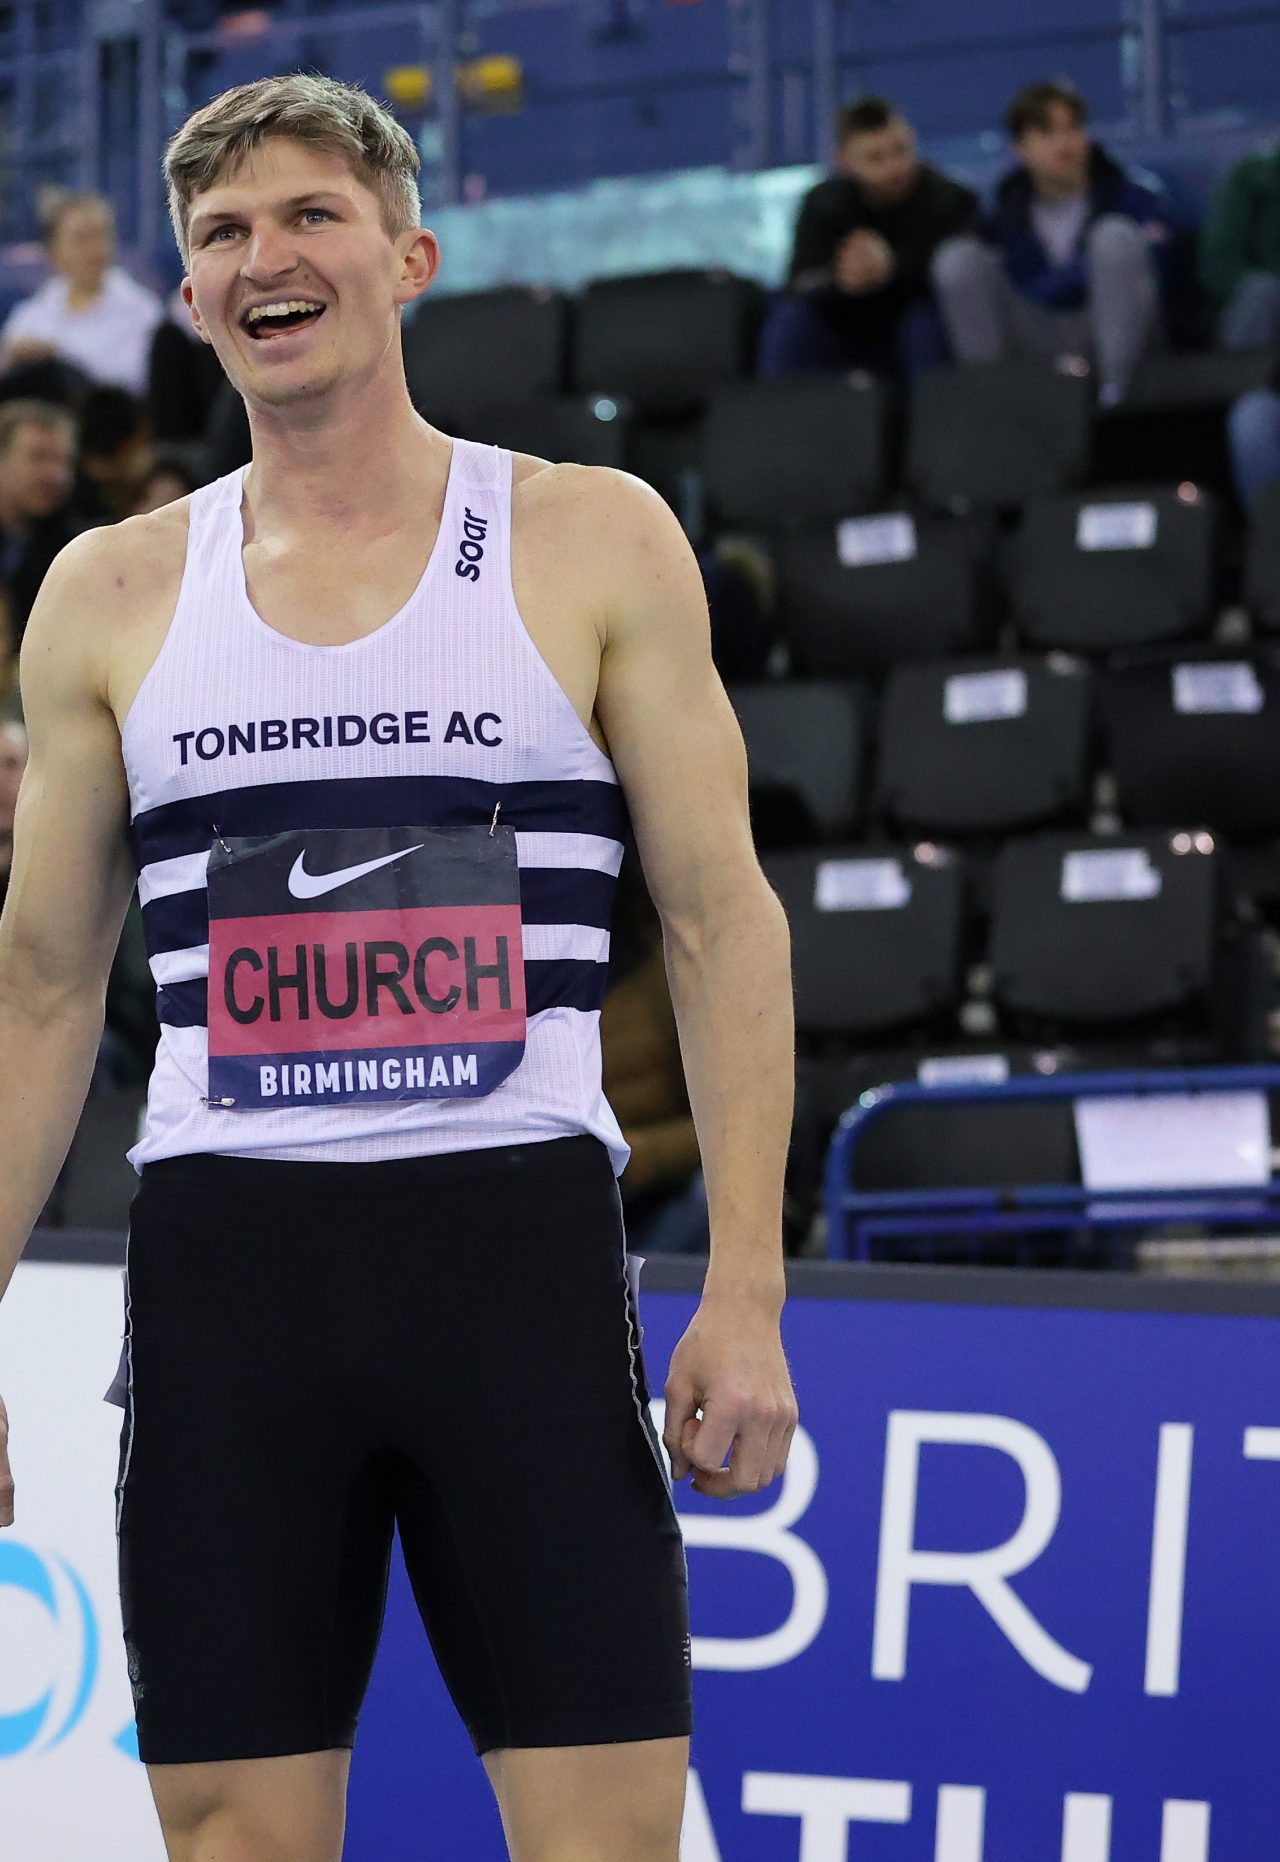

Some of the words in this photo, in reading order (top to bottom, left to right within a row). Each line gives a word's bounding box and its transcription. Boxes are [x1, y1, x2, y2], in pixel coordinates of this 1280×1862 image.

[455, 508, 488, 583] soar
[173, 711, 431, 766] TONBRIDGE
[443, 711, 504, 747] AC
[224, 935, 510, 1025] CHURCH
[259, 1053, 478, 1097] BIRMINGHAM
[649, 1397, 1280, 1698] BRI
